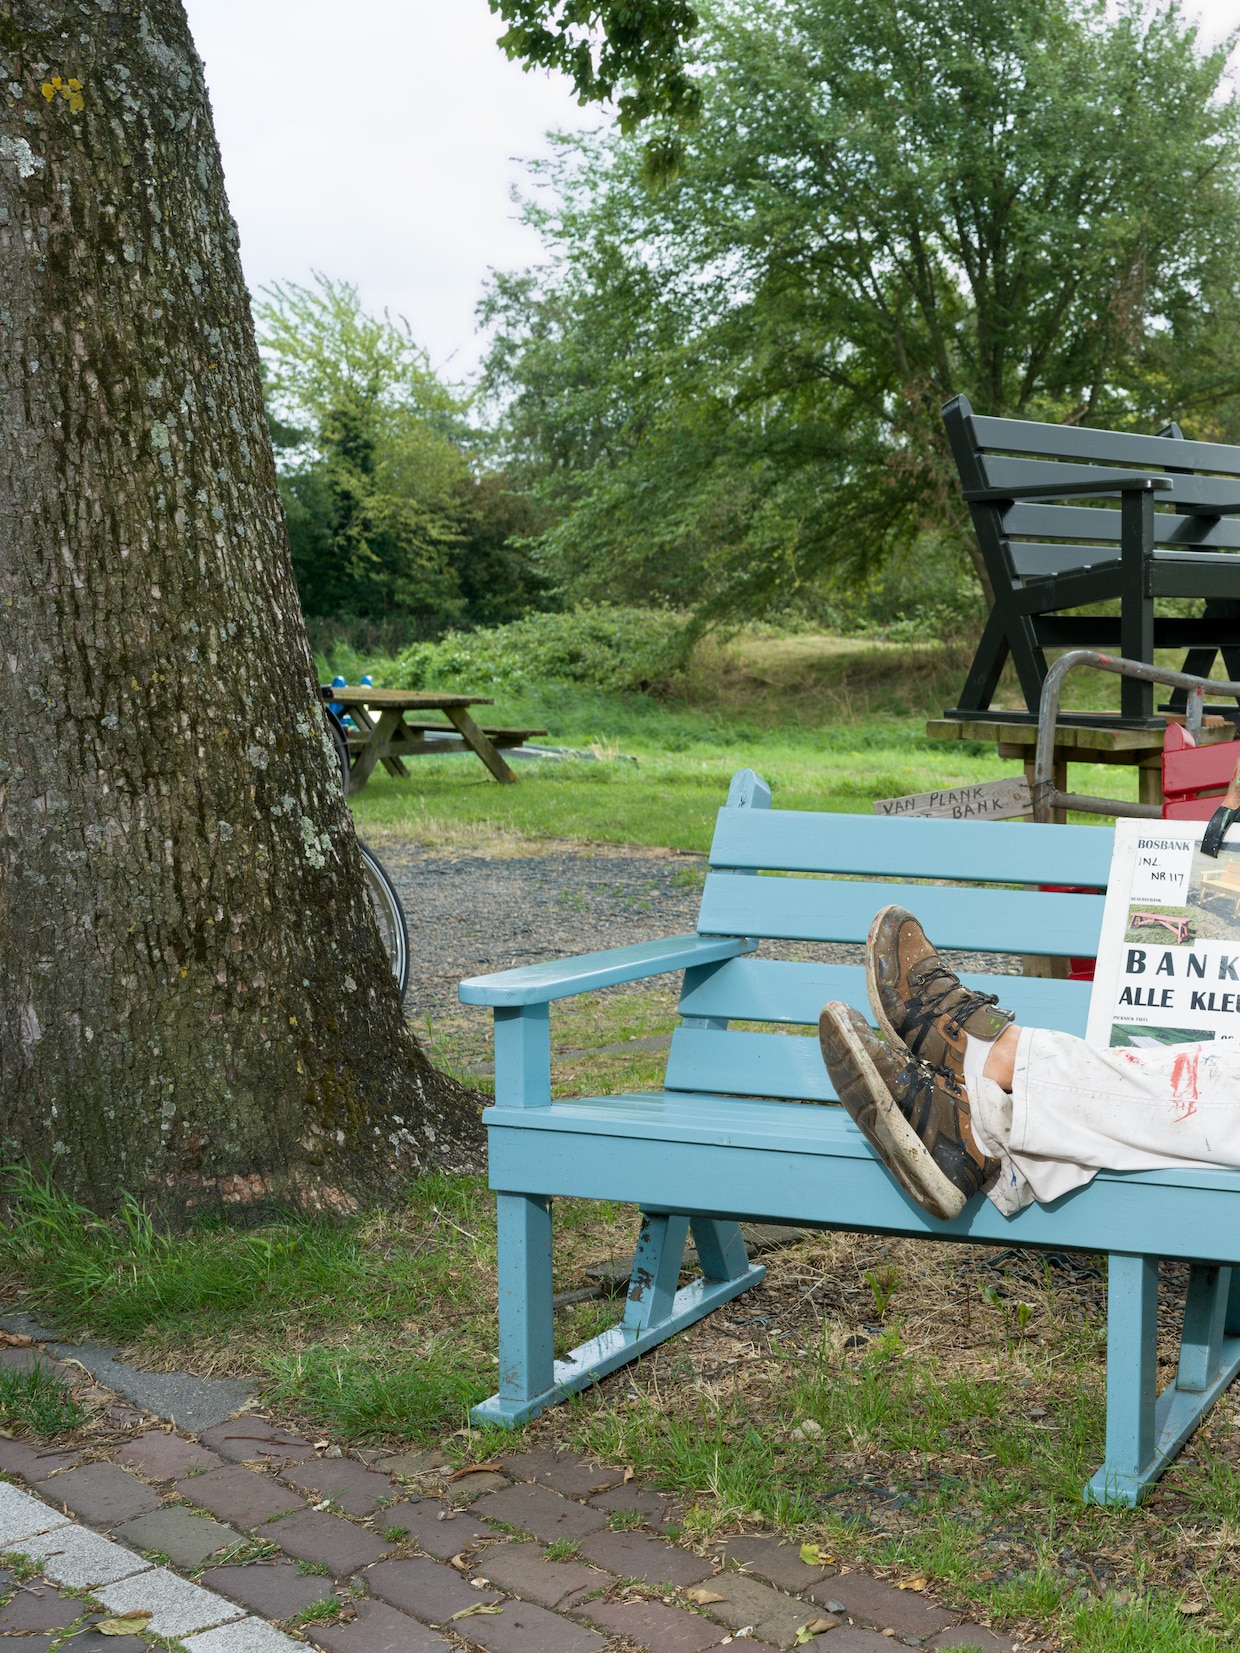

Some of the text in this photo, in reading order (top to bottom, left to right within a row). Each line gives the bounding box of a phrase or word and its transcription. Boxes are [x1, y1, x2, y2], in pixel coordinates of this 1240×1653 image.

[883, 787, 985, 815] VAN PLANK
[953, 798, 1003, 819] BANK
[1137, 839, 1190, 851] BOSBANK
[1151, 871, 1184, 888] NR 117
[1119, 986, 1174, 1009] ALLE
